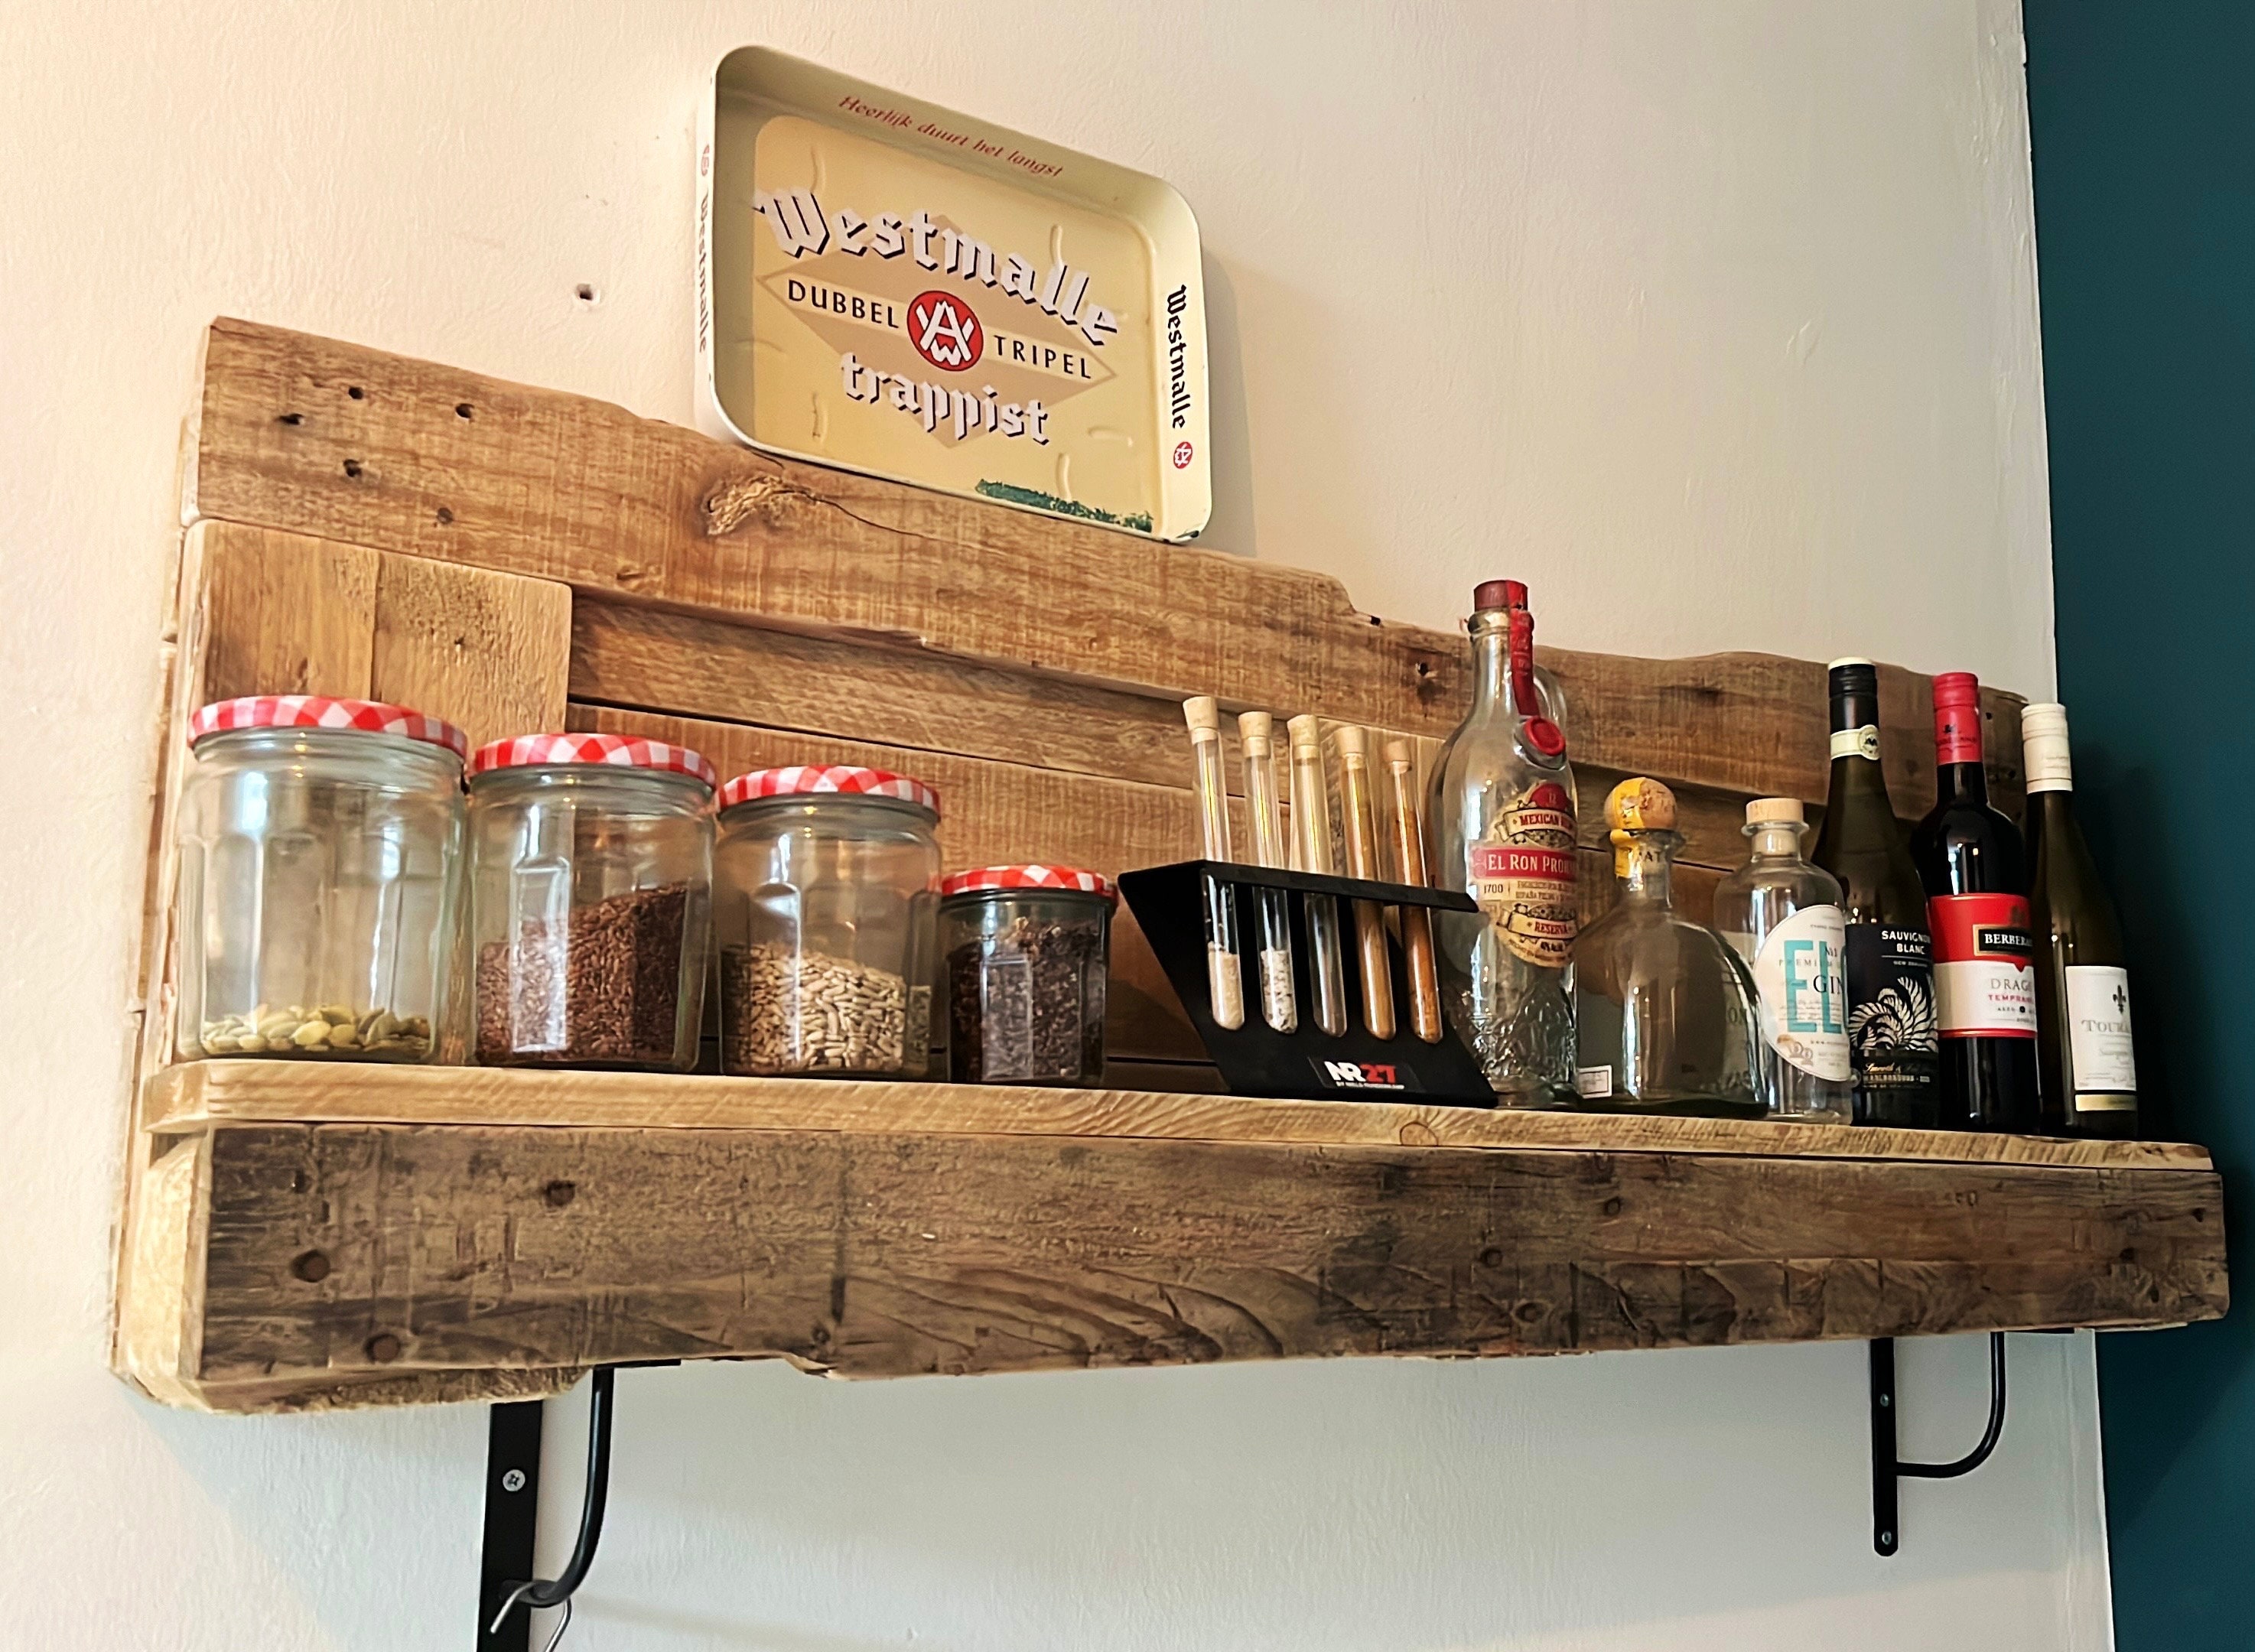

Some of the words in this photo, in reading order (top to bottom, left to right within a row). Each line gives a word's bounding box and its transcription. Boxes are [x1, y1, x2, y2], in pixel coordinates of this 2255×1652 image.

[838, 96, 913, 128] Heerlijk
[917, 122, 969, 147] duurt
[972, 138, 1004, 158] het
[1007, 150, 1063, 178] langst
[753, 185, 1118, 346] Westmalle
[788, 278, 900, 329] DUBBEL
[993, 334, 1092, 380] TRIPEL
[1167, 284, 1191, 429] Westmalle
[840, 351, 1050, 446] trappist
[1519, 813, 1560, 827] MEXICAN
[1488, 854, 1505, 870] EL
[1509, 854, 1538, 871] RON
[1483, 883, 1503, 894] 1700
[1534, 921, 1568, 935] RESERVA
[1896, 942, 1925, 955] BLANC
[1324, 1061, 1396, 1085] NR27
